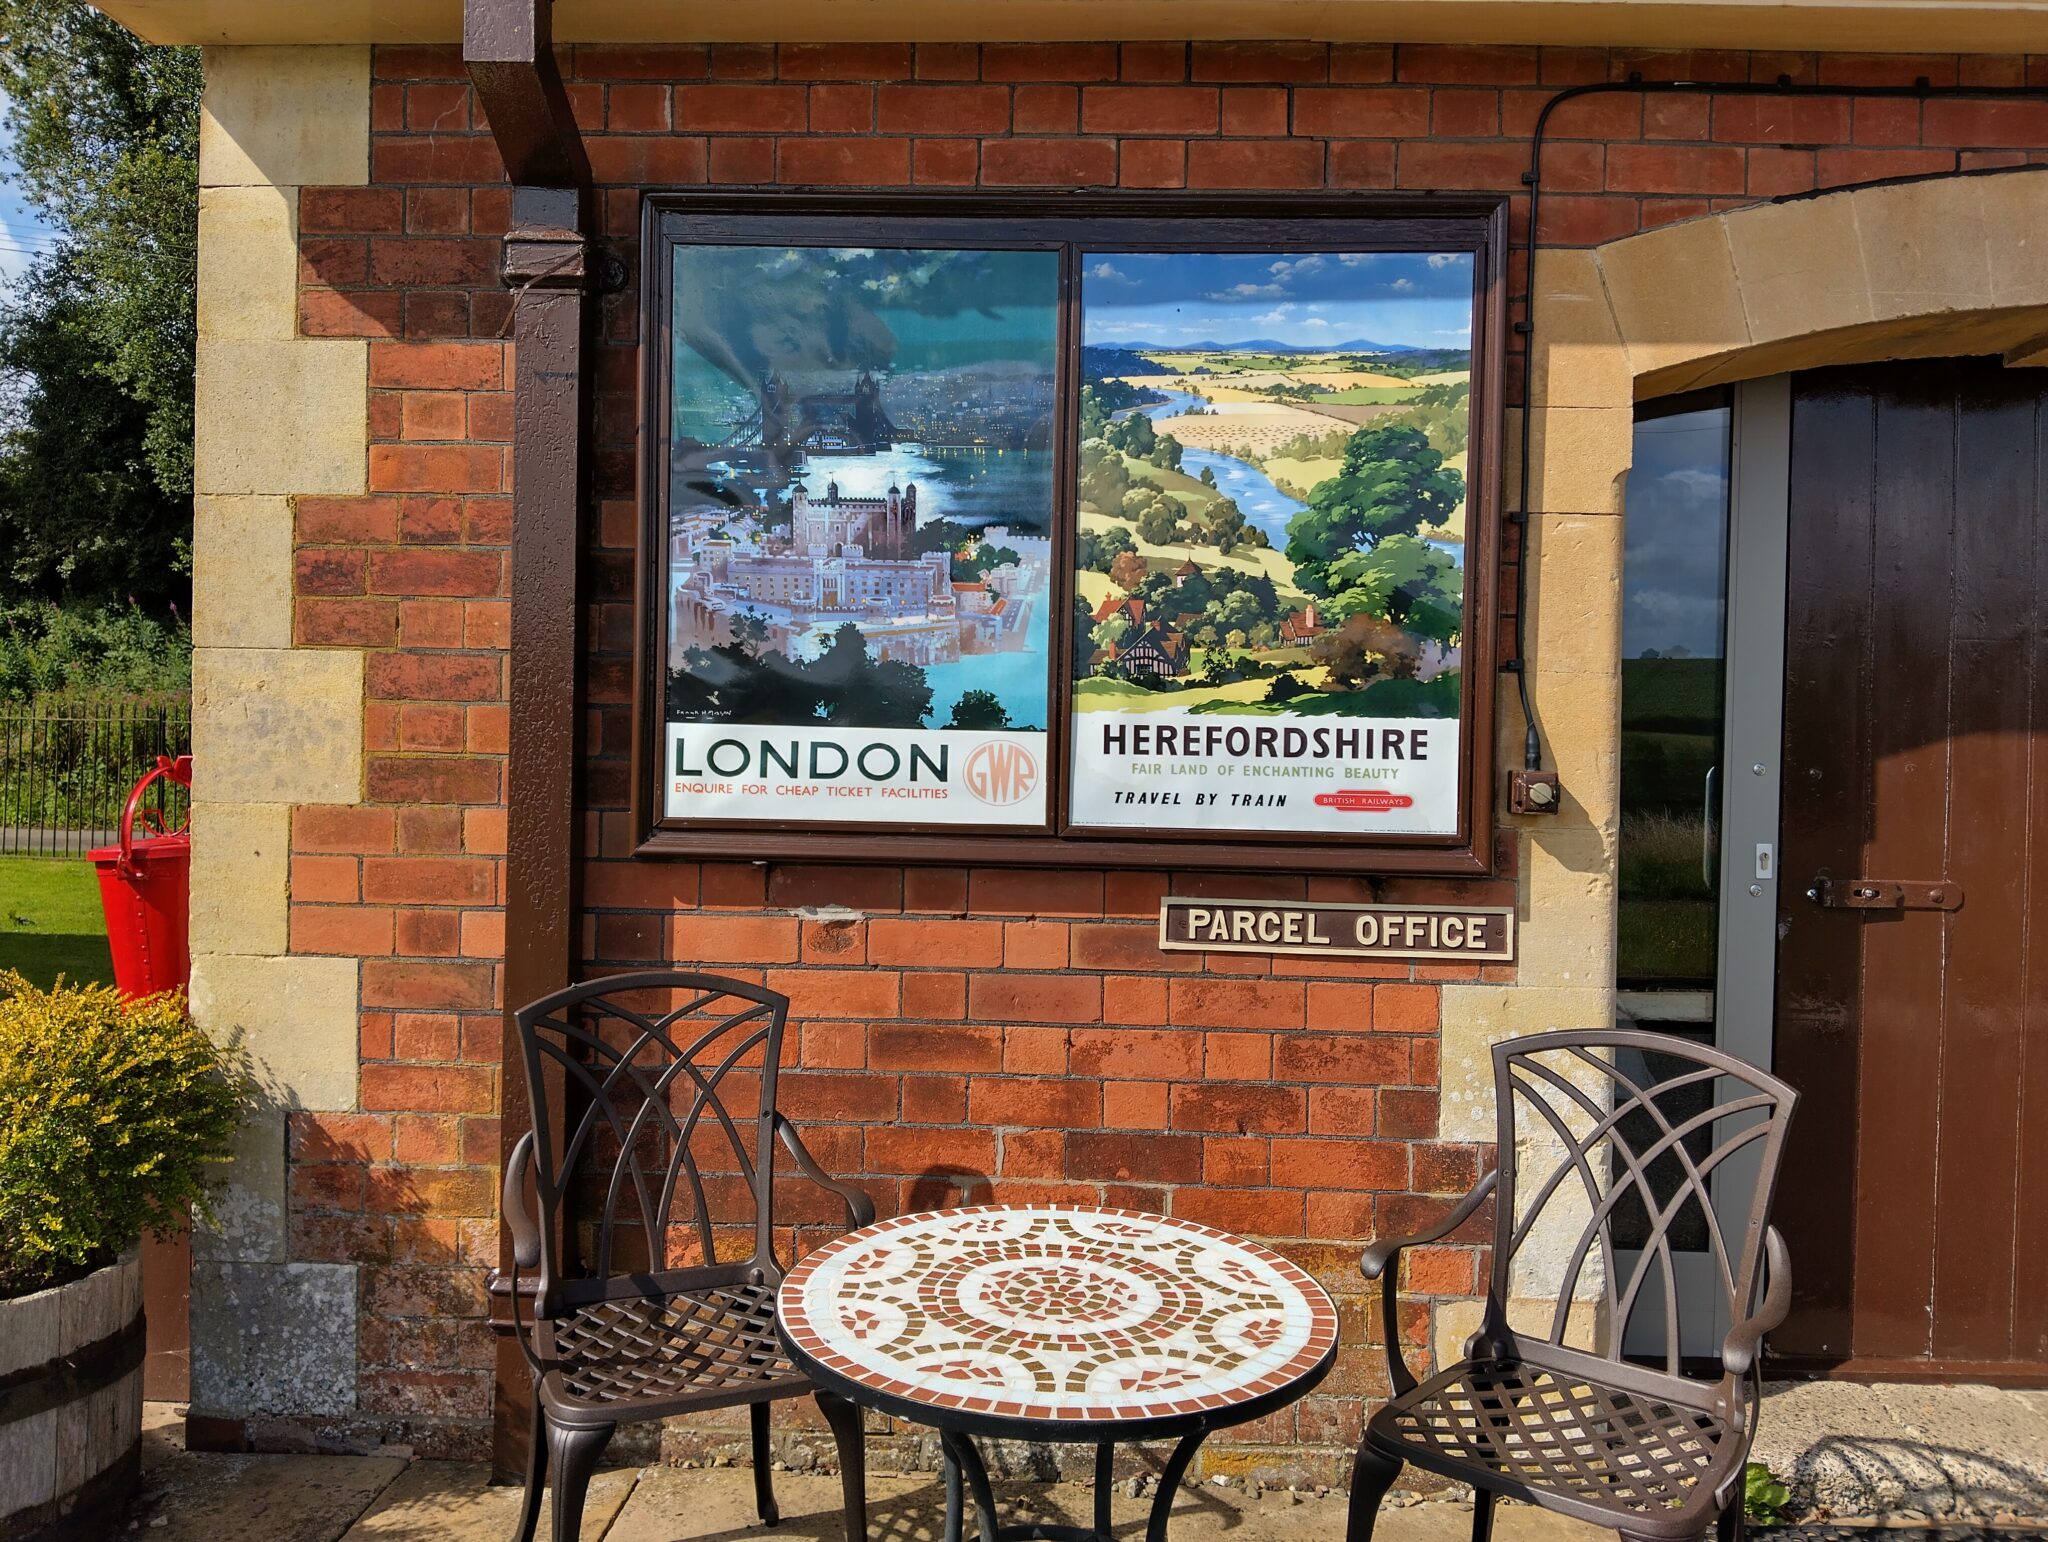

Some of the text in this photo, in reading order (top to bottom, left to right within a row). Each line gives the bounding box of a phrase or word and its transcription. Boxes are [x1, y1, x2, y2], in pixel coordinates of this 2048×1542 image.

[1103, 723, 1429, 761] HEREFORDSHIRE
[675, 738, 949, 783] LONDON
[966, 742, 1036, 804] GWR
[1131, 762, 1399, 780] FAIR LAND OF ENCHANTING BEAUTY
[675, 782, 949, 800] ENQUIRE FOR CHEAP TICKET FACILITIES
[1114, 791, 1288, 807] TRAVEL BY TRAIN
[1361, 798, 1404, 806] RAILWAYS
[1188, 909, 1487, 949] PARCEL OFFICE
